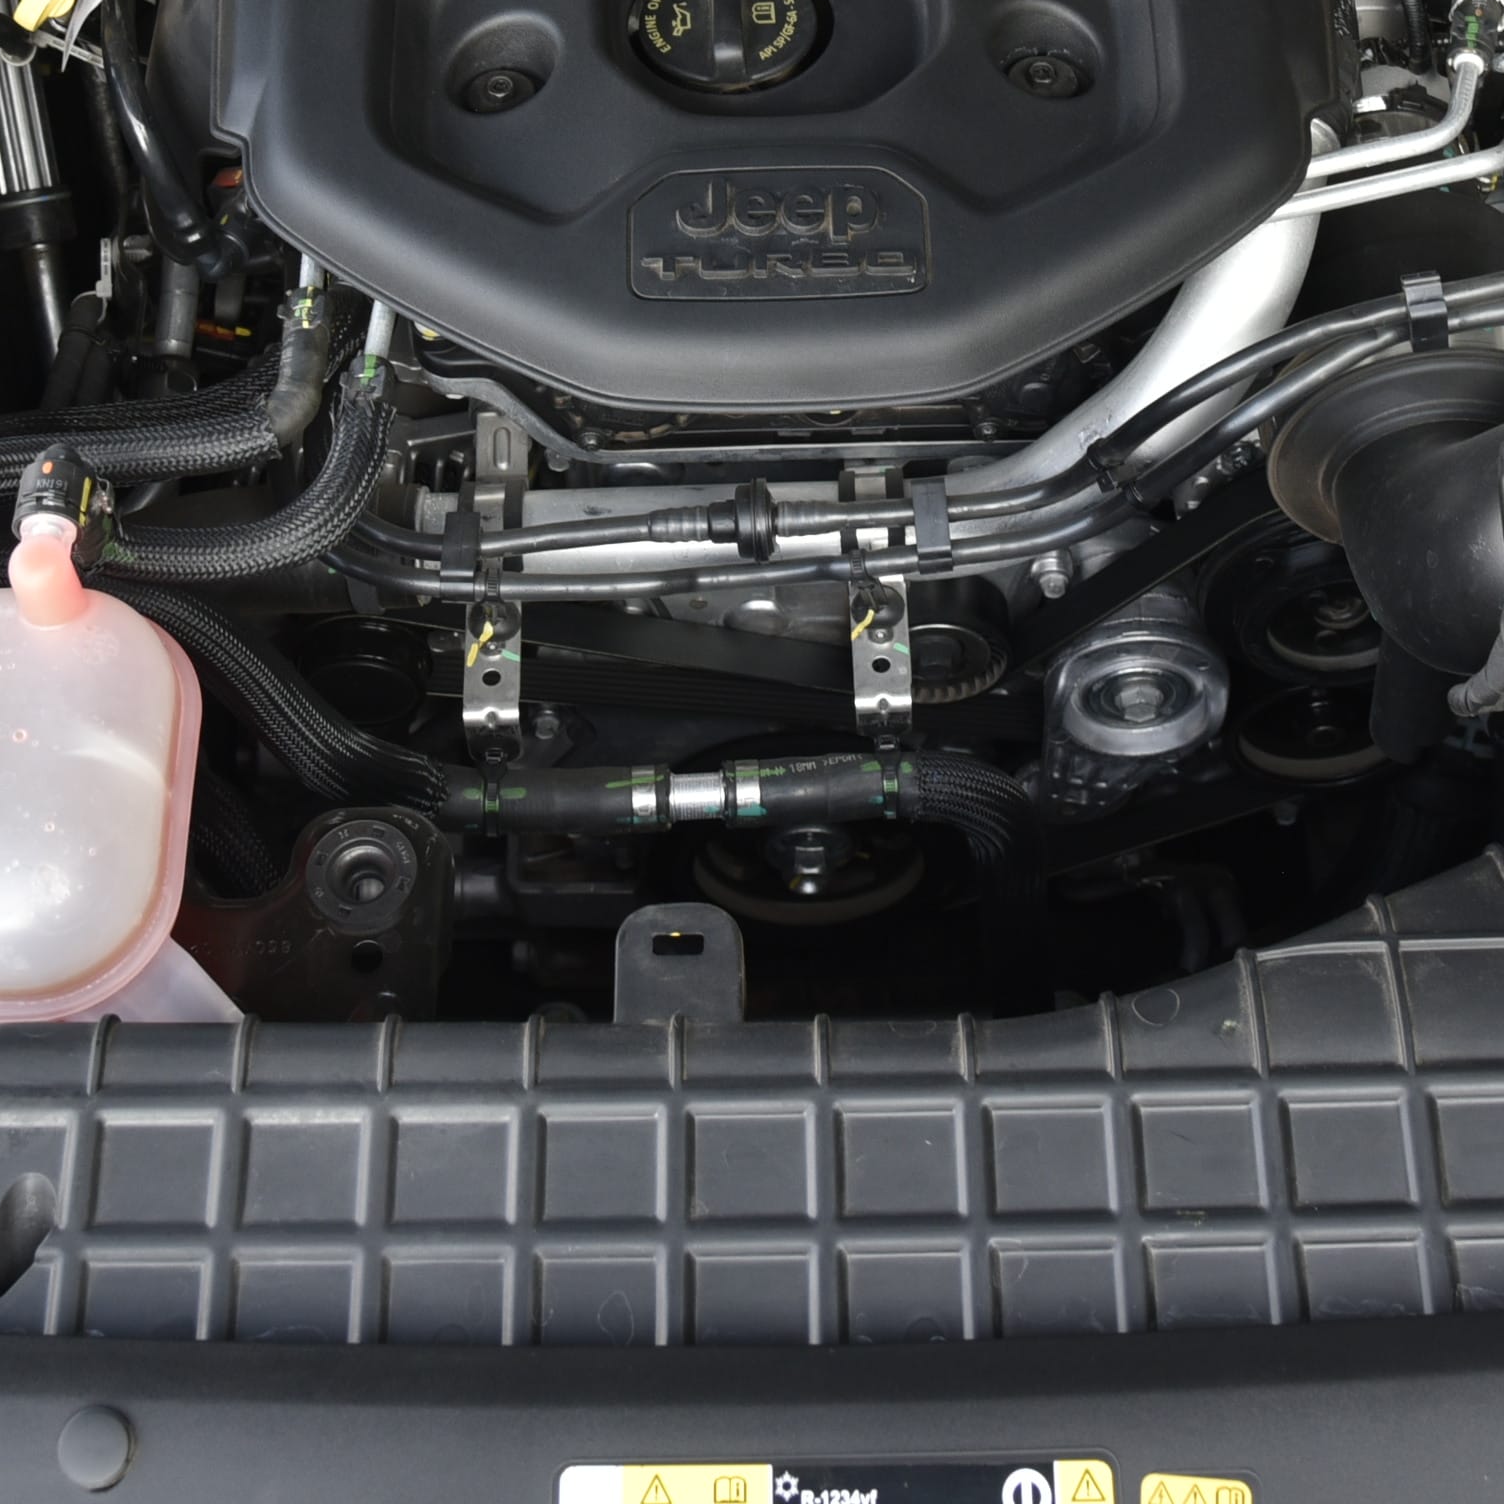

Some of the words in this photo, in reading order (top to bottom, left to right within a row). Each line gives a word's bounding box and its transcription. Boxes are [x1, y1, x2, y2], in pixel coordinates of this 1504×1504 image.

[645, 14, 672, 54] ENGINE
[758, 46, 776, 61] API
[675, 177, 880, 246] Jeep
[641, 248, 917, 281] TURBO
